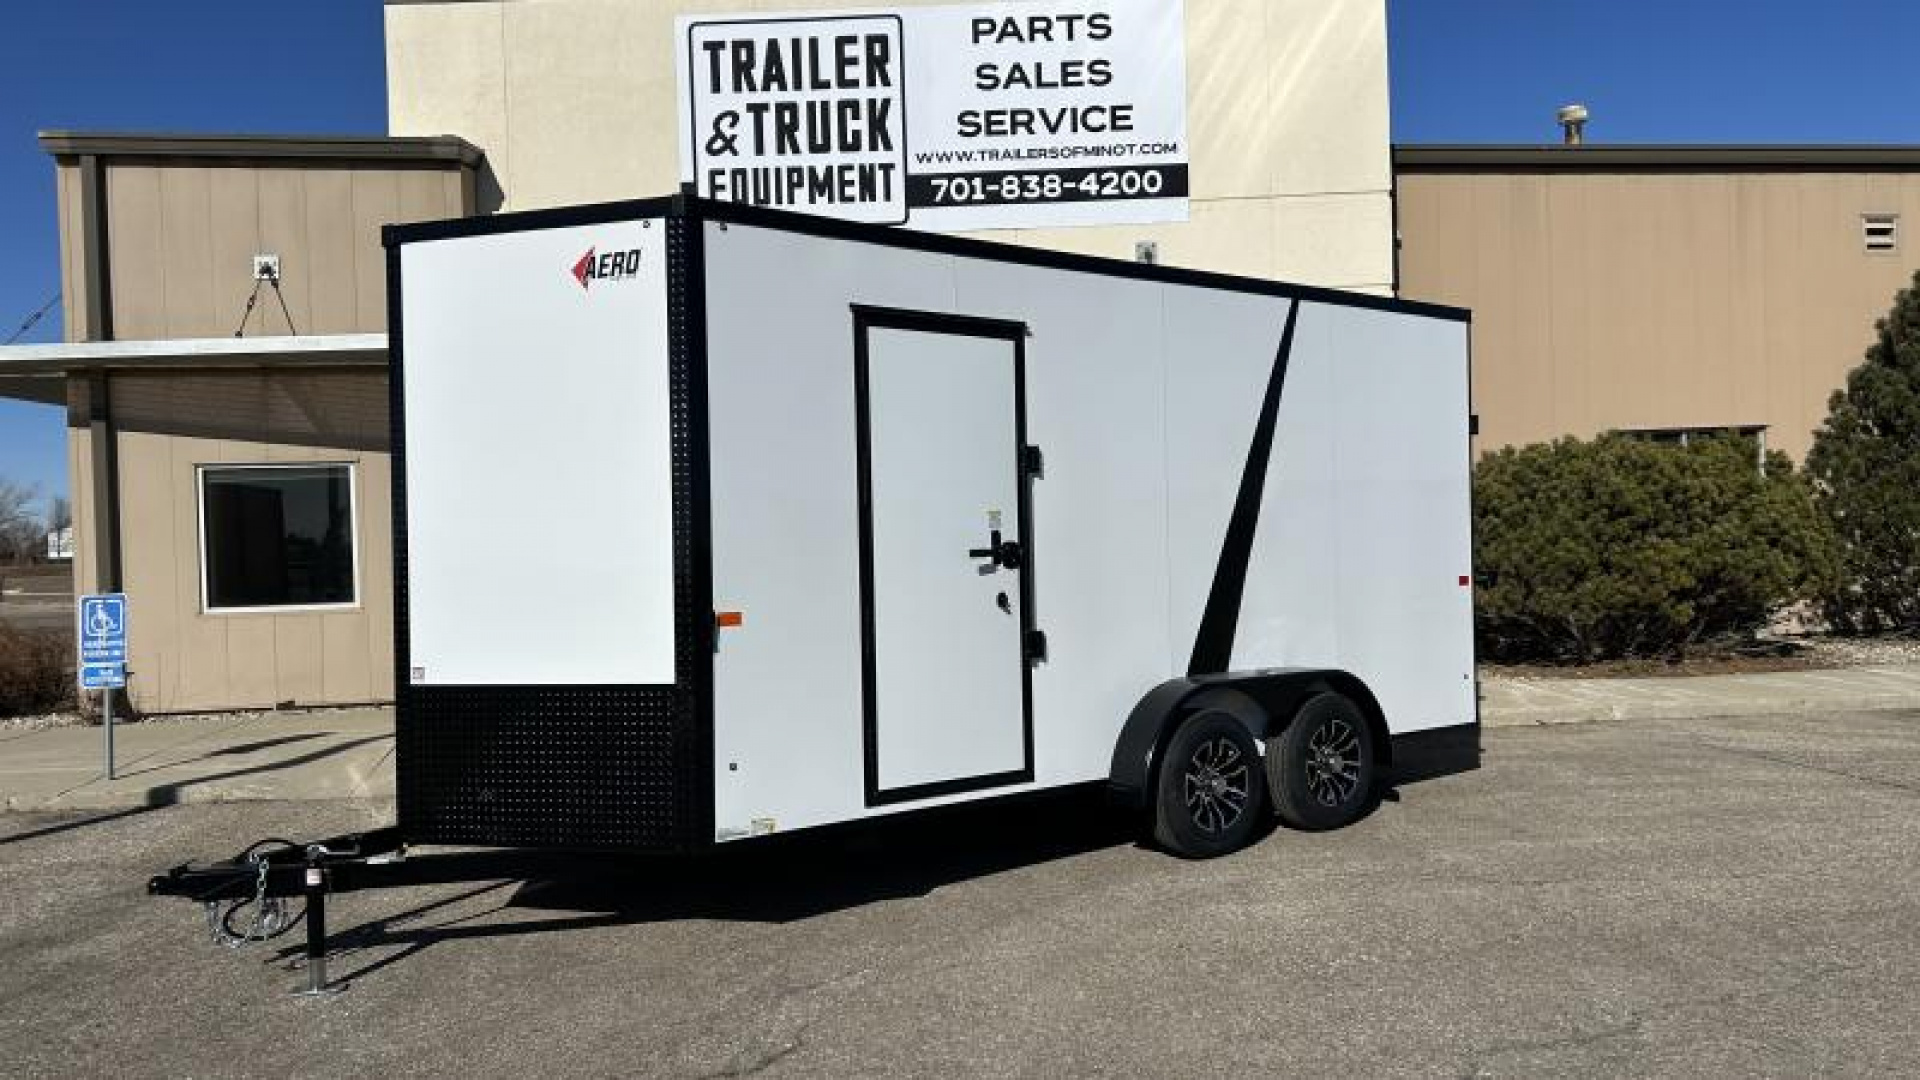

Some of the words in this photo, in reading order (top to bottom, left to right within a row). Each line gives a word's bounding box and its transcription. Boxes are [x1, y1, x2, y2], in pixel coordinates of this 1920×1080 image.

[971, 12, 1113, 43] PARTS
[702, 33, 892, 94] TRAILER
[975, 59, 1113, 90] SALES
[705, 110, 740, 156] &
[746, 97, 893, 156] TRUCK
[957, 104, 1134, 137] SERVICE
[915, 142, 1178, 163] WWW.TRAILERSOFMINOT.COM
[707, 162, 896, 205] EQUIPMENT
[930, 169, 1162, 202] 701-838-4200
[582, 248, 642, 279] AERO
